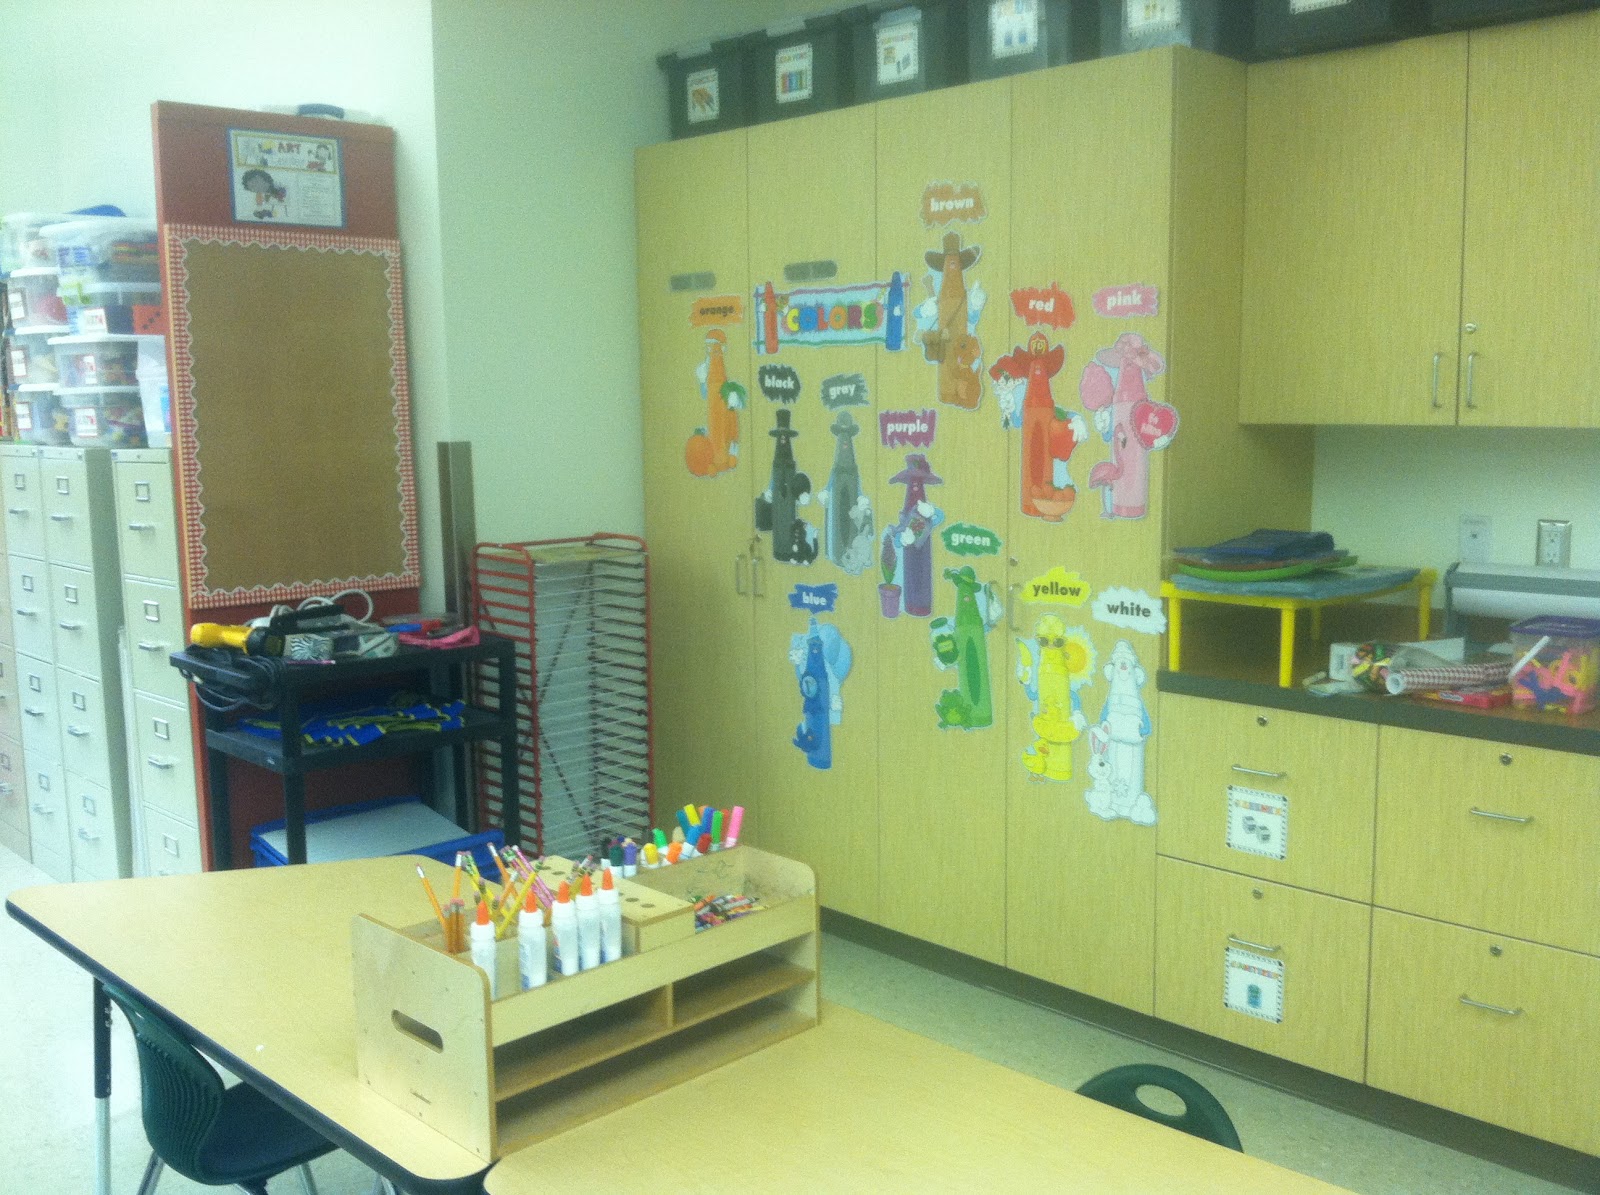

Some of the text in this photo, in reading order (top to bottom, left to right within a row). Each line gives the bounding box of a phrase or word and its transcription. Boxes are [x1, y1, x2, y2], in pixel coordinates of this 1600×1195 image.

[930, 195, 974, 211] brown
[1028, 298, 1055, 312] red
[1106, 292, 1142, 310] pink
[700, 303, 734, 316] orange
[785, 302, 881, 331] COLORS
[765, 375, 794, 390] black
[829, 382, 855, 397] gray
[886, 420, 928, 435] purple
[950, 532, 991, 547] green
[1032, 582, 1081, 597] yellow
[802, 592, 827, 606] blue
[1106, 602, 1151, 618] white
